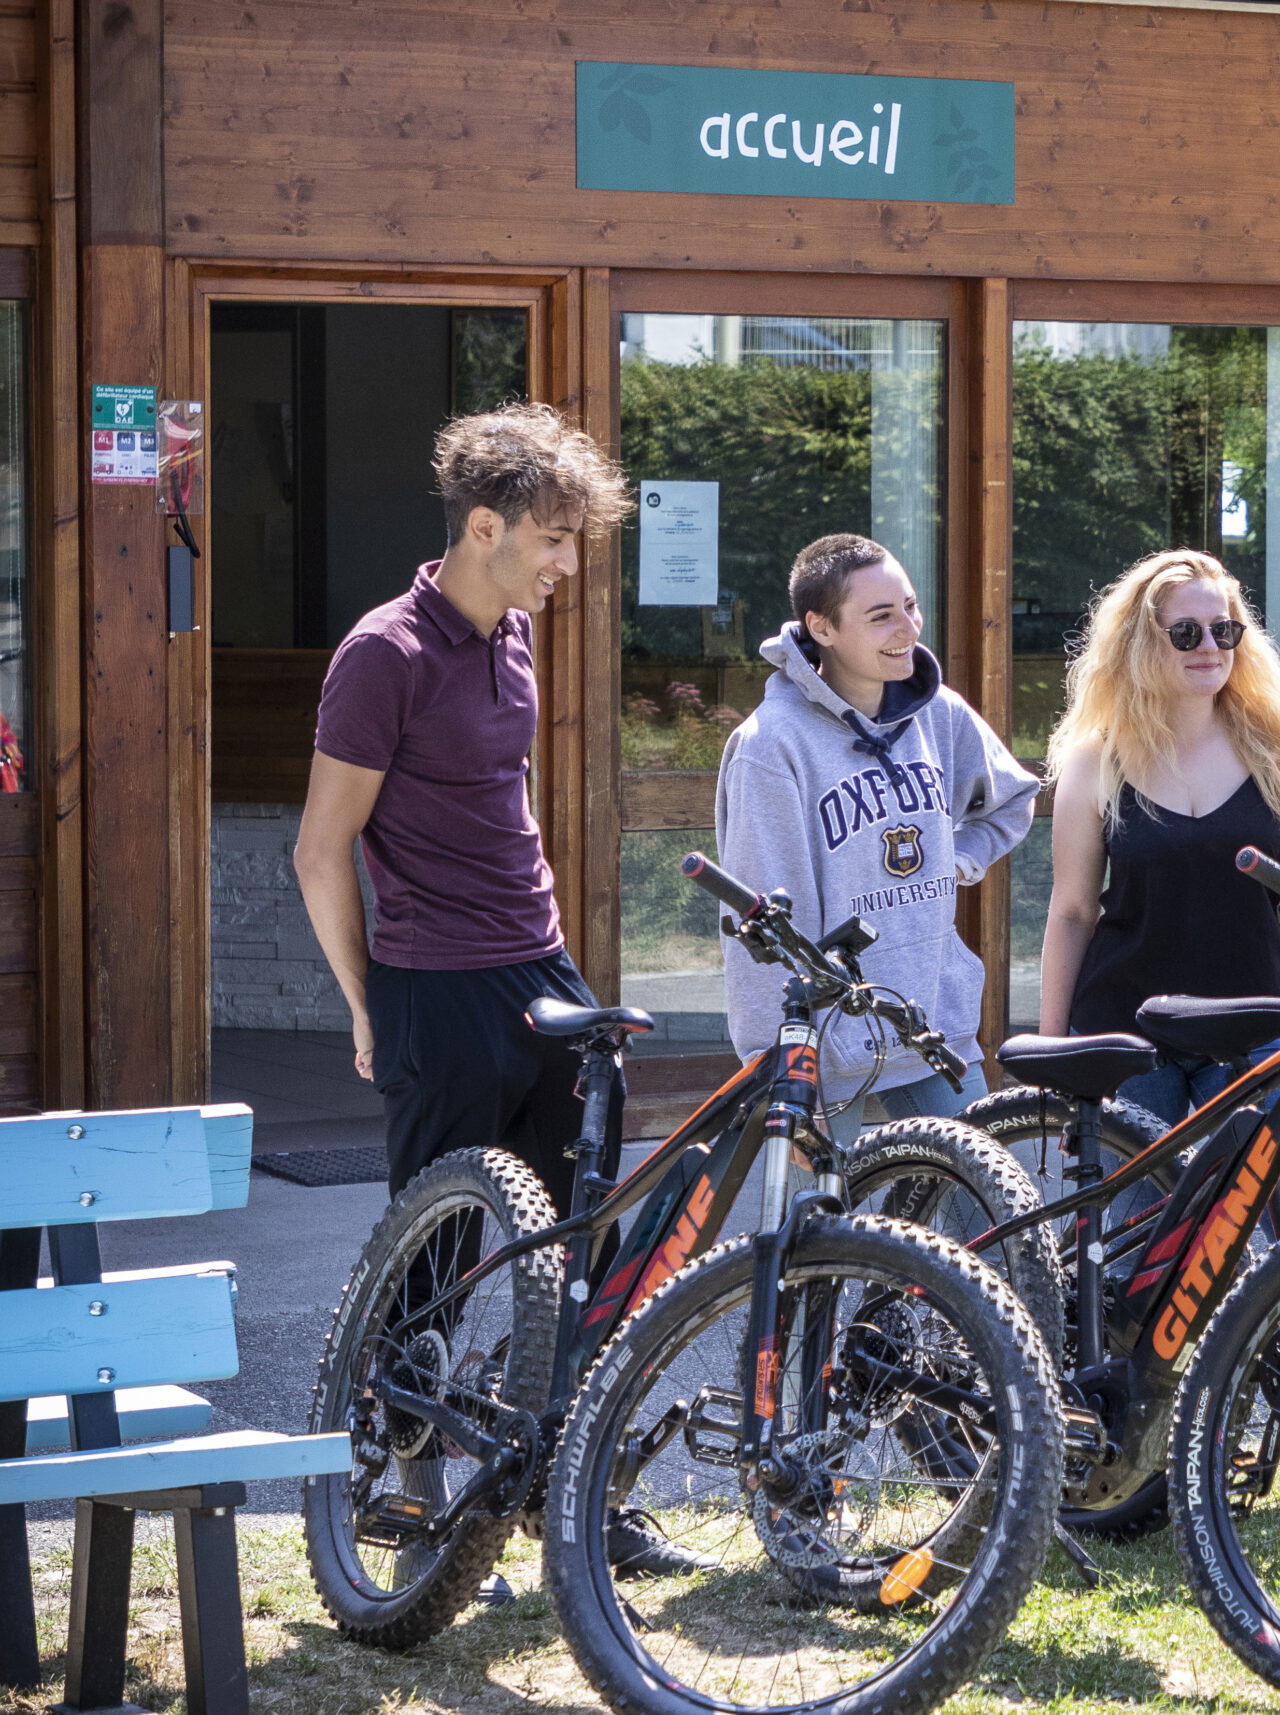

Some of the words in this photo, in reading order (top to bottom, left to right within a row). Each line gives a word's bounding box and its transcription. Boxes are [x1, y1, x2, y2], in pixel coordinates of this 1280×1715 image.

[700, 102, 901, 174] accueil
[115, 416, 133, 424] DAE
[818, 761, 952, 853] OXFOR
[851, 876, 958, 916] UNIVERSITY
[881, 1144, 930, 1158] TAIPAN
[636, 1174, 714, 1305] ANE
[1153, 1125, 1276, 1360] GITANE
[561, 1344, 634, 1544] SCHWALBE
[1187, 1429, 1206, 1511] TAIPAN
[1192, 1515, 1261, 1635] HUTCHINSON
